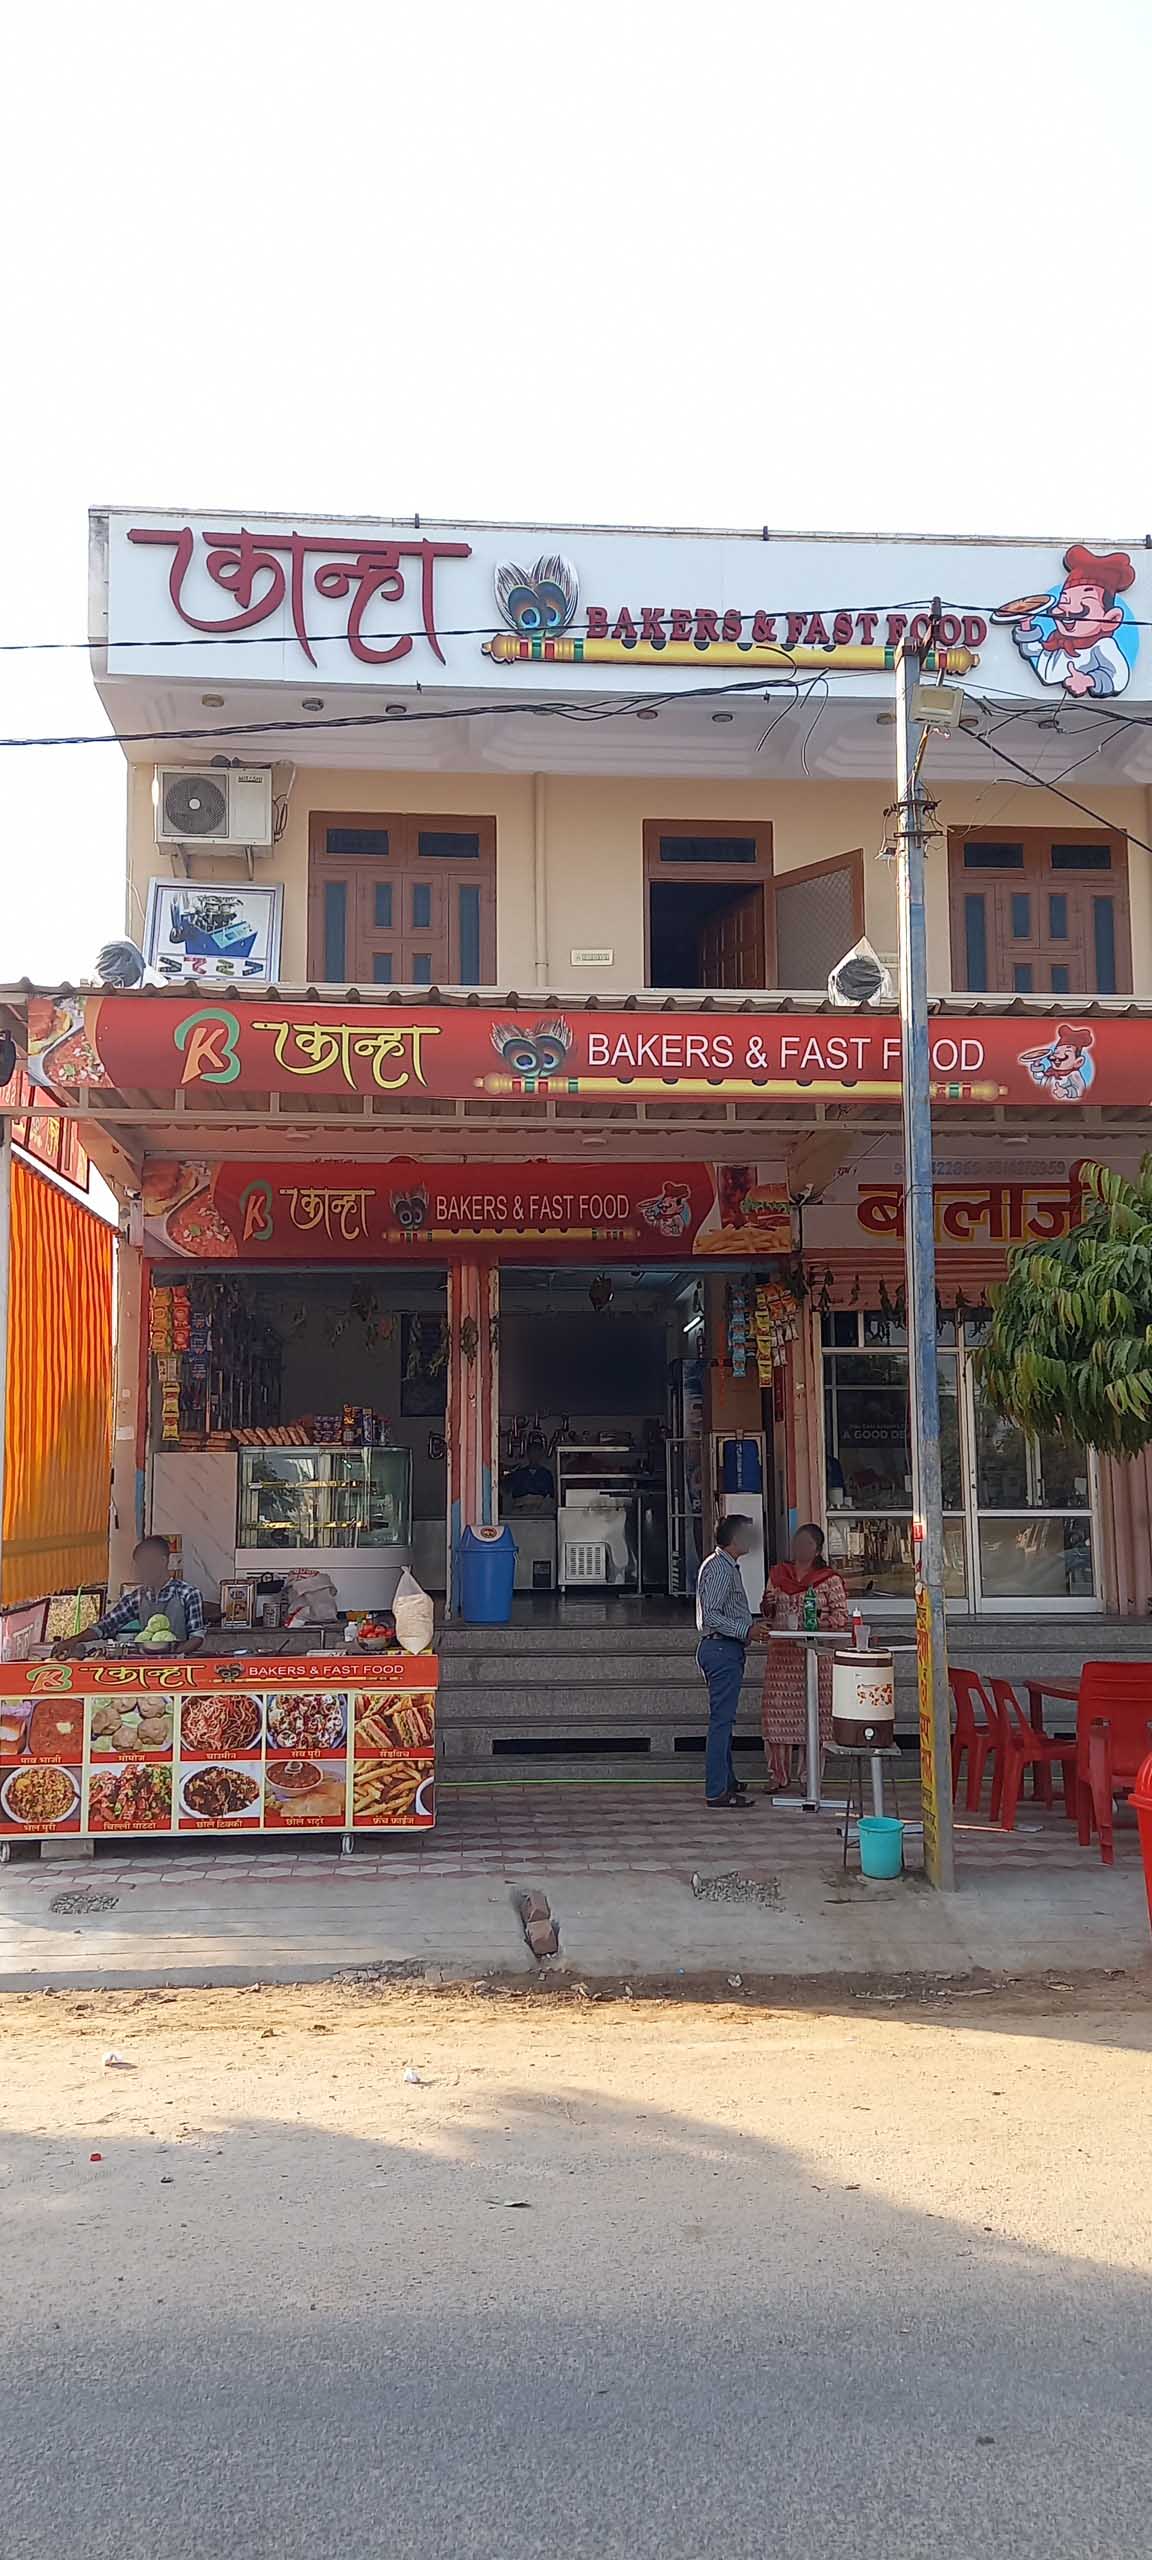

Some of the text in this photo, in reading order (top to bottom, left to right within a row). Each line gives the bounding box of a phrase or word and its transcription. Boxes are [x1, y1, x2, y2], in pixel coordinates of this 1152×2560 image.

[127, 526, 472, 669] कान्हा
[586, 606, 988, 647] BAKERS & FAST FOOD
[251, 1021, 442, 1090] कान्हा
[587, 1033, 984, 1071] BAKERS & FAST FOD
[279, 1186, 376, 1240] कान्हा
[436, 1194, 630, 1220] BAKERS & FAST FOOD
[854, 1430, 888, 1440] GOOD
[80, 1665, 206, 1688] कान्हा
[249, 1665, 404, 1676] BAKERS & FAST FOOD
